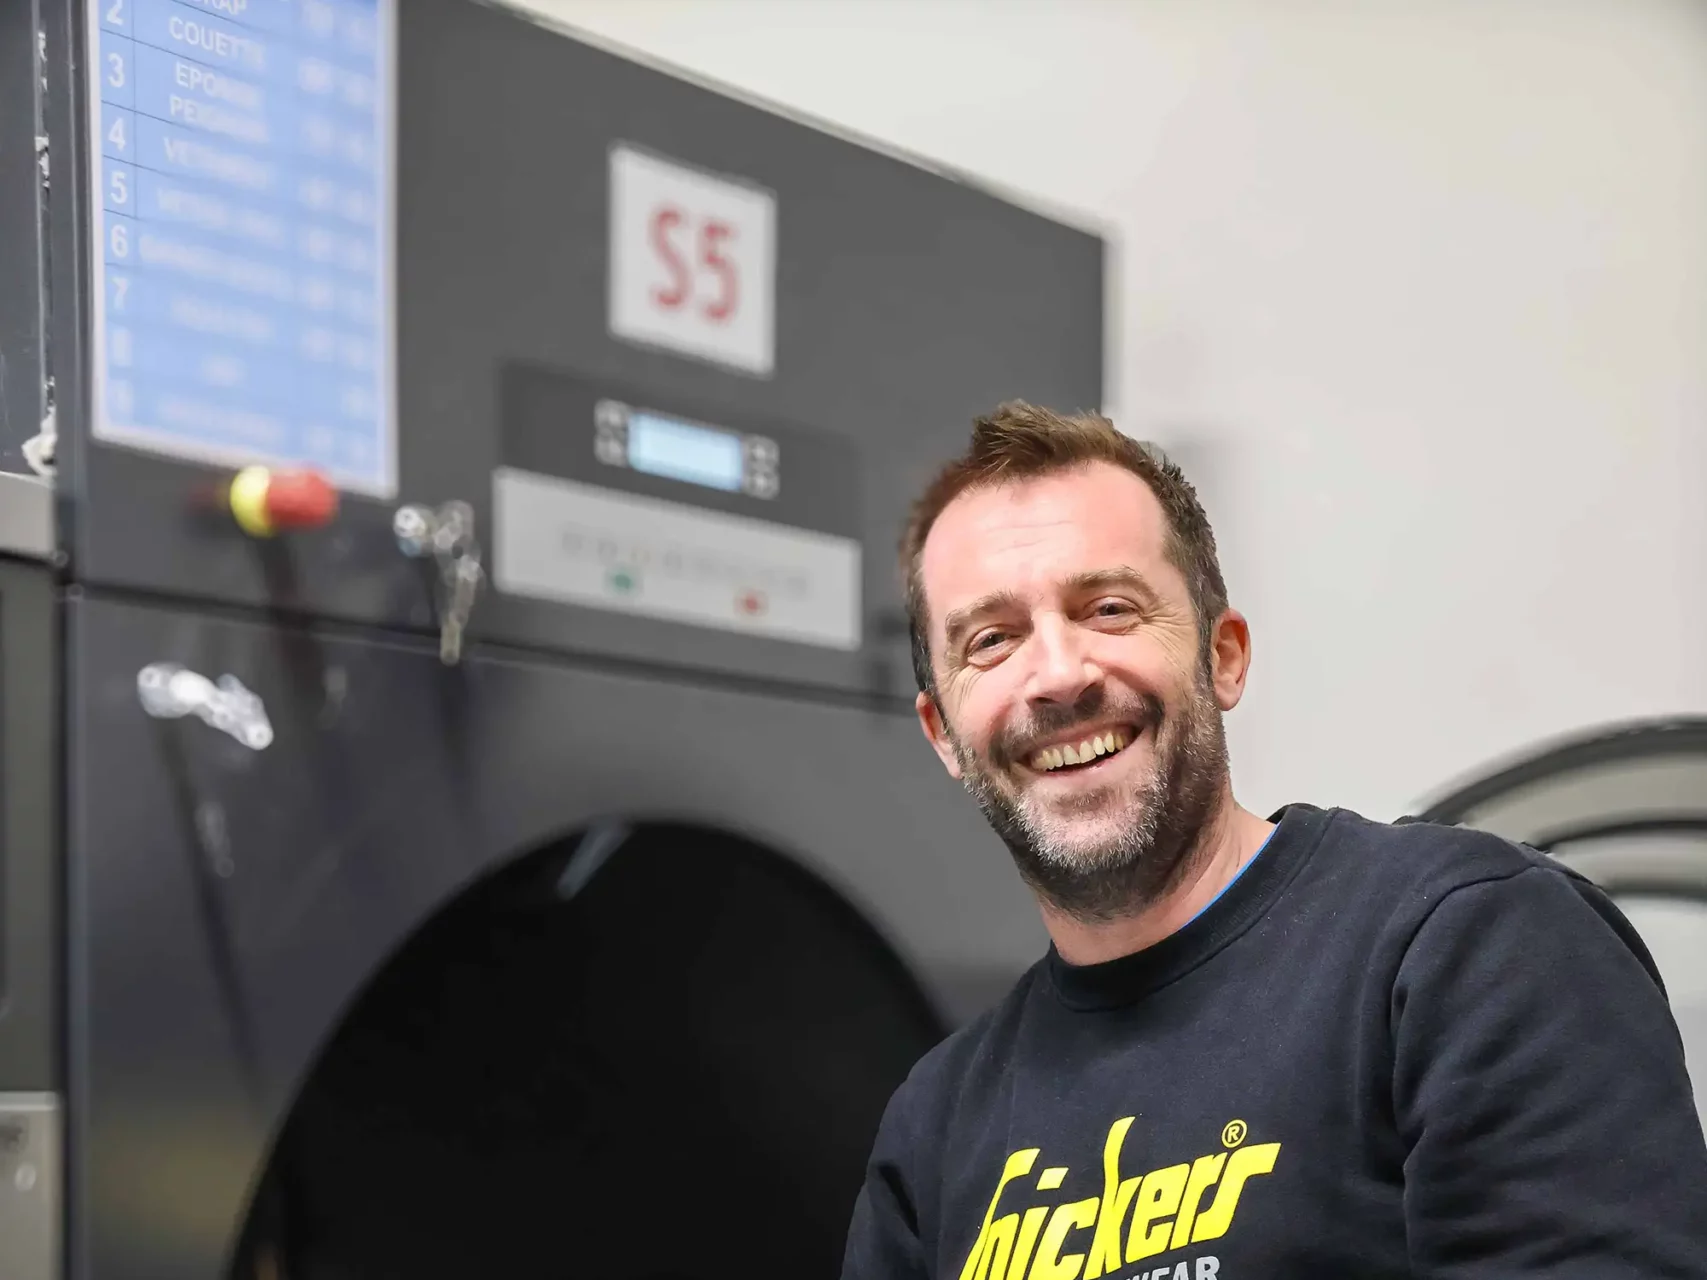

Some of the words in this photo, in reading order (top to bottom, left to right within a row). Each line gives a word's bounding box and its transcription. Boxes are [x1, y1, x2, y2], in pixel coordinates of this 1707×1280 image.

[107, 52, 125, 88] 3
[108, 117, 126, 151] 4
[110, 170, 127, 204] 5
[110, 224, 128, 258] 6
[648, 205, 742, 323] S5
